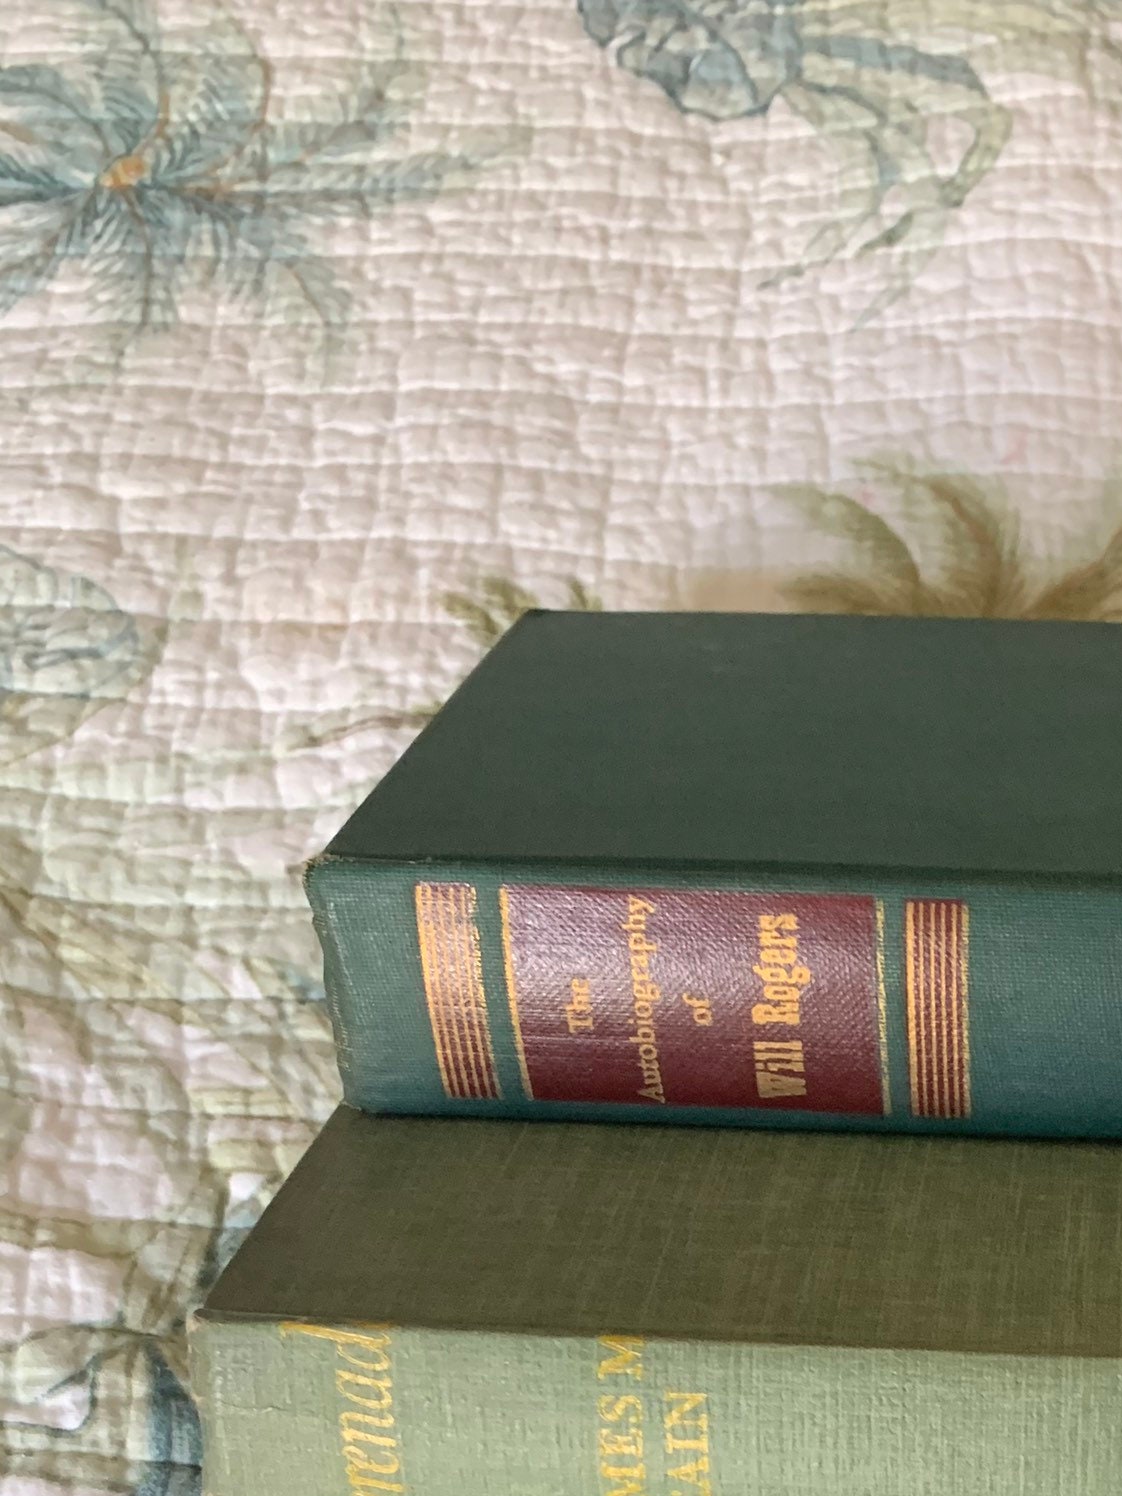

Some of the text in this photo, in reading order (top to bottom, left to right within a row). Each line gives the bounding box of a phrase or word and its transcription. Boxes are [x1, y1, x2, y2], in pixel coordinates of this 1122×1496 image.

[566, 977, 595, 1034] The
[622, 895, 666, 1105] Autobiography
[682, 993, 713, 1028] of
[752, 913, 810, 1099] Will Rogers
